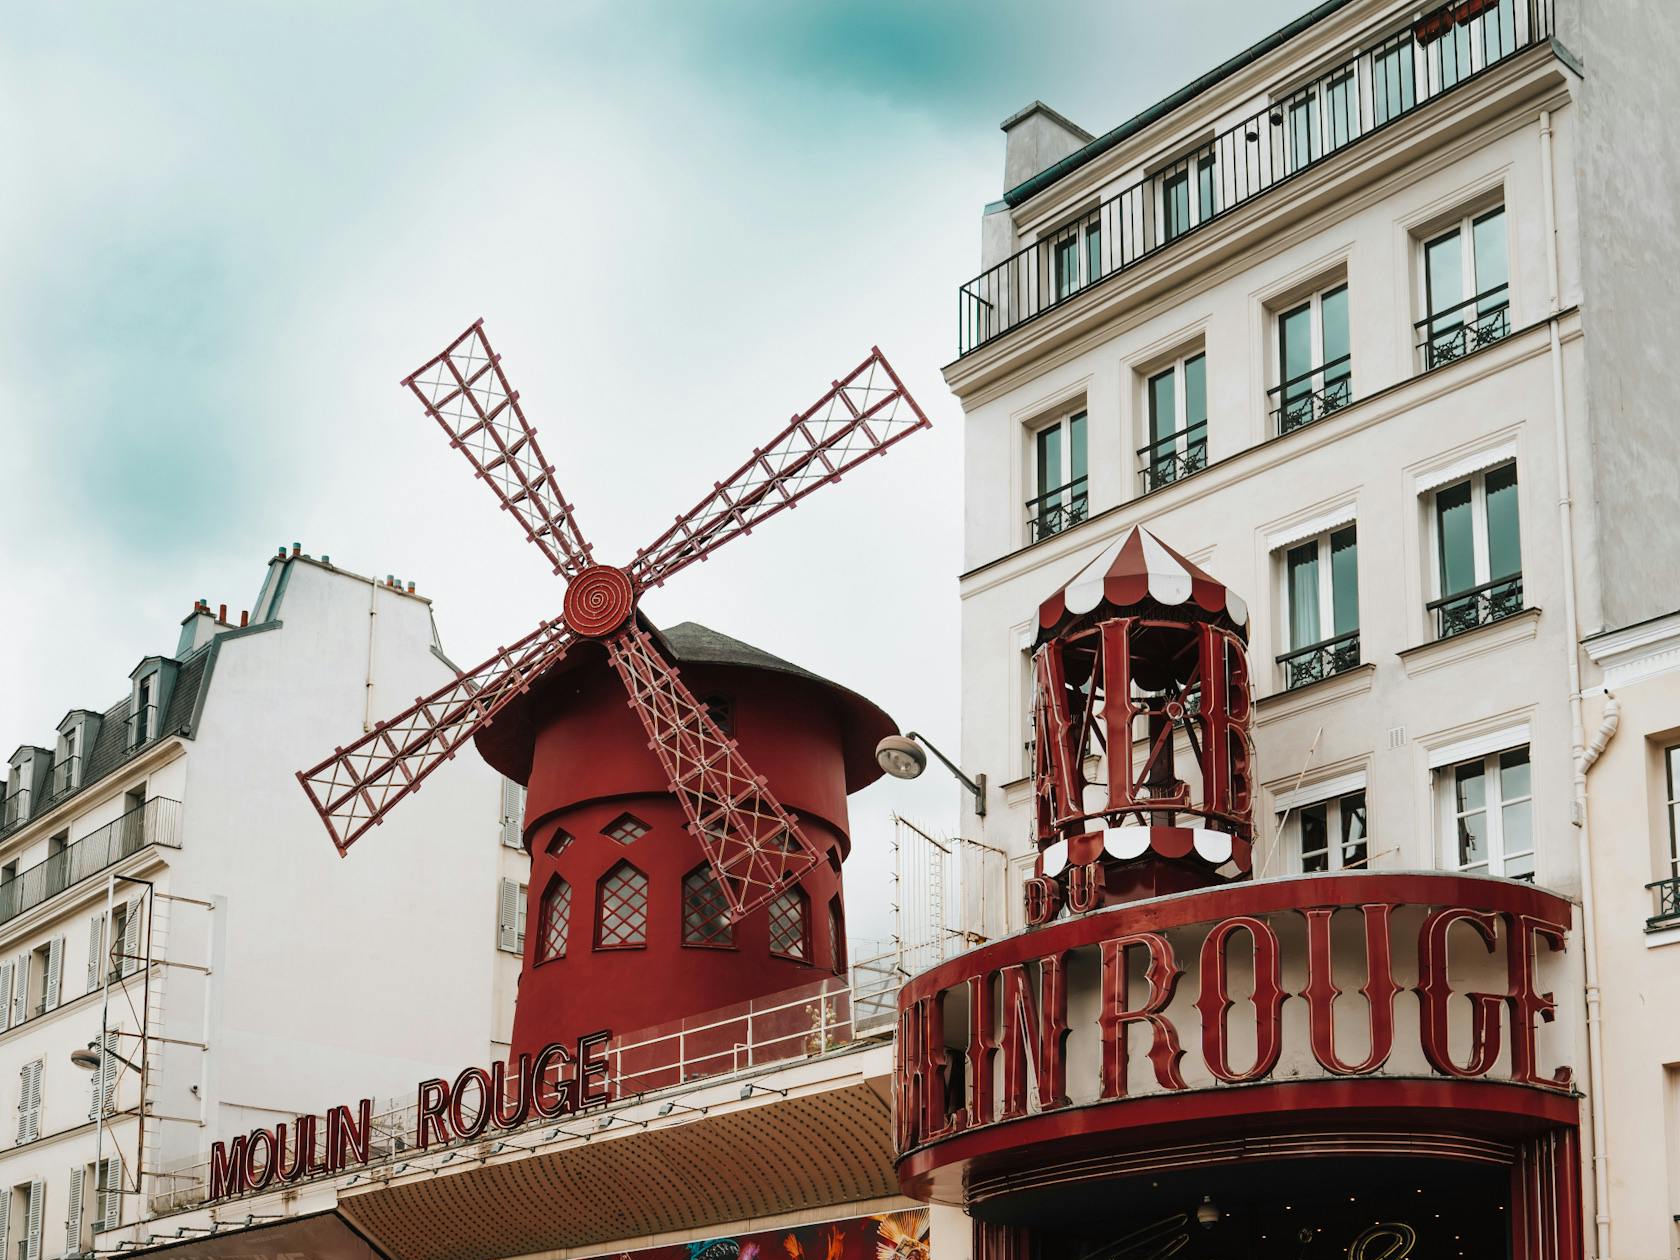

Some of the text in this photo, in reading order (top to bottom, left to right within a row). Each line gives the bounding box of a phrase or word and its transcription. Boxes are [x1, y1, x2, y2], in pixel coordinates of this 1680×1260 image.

[1098, 904, 1577, 1099] ROUGE
[209, 1029, 613, 1200] MOULIN ROUGE
